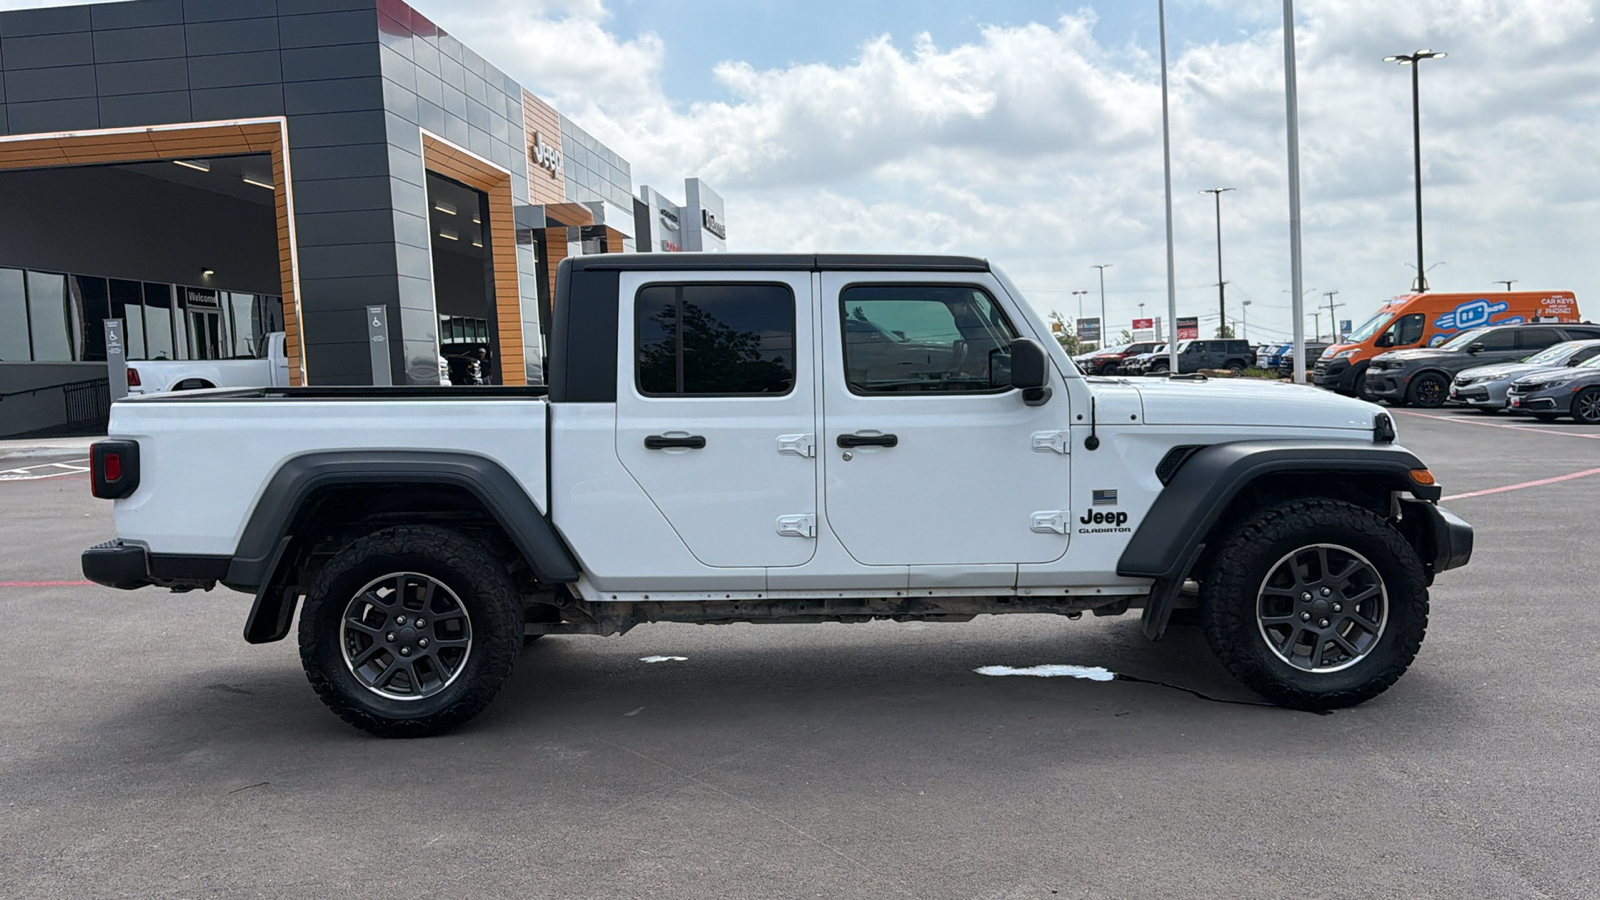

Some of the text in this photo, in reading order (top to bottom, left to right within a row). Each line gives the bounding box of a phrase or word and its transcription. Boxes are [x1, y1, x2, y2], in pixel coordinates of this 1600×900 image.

[532, 131, 560, 179] Jeep
[188, 291, 217, 303] Welcome
[1080, 508, 1128, 527] Jeep
